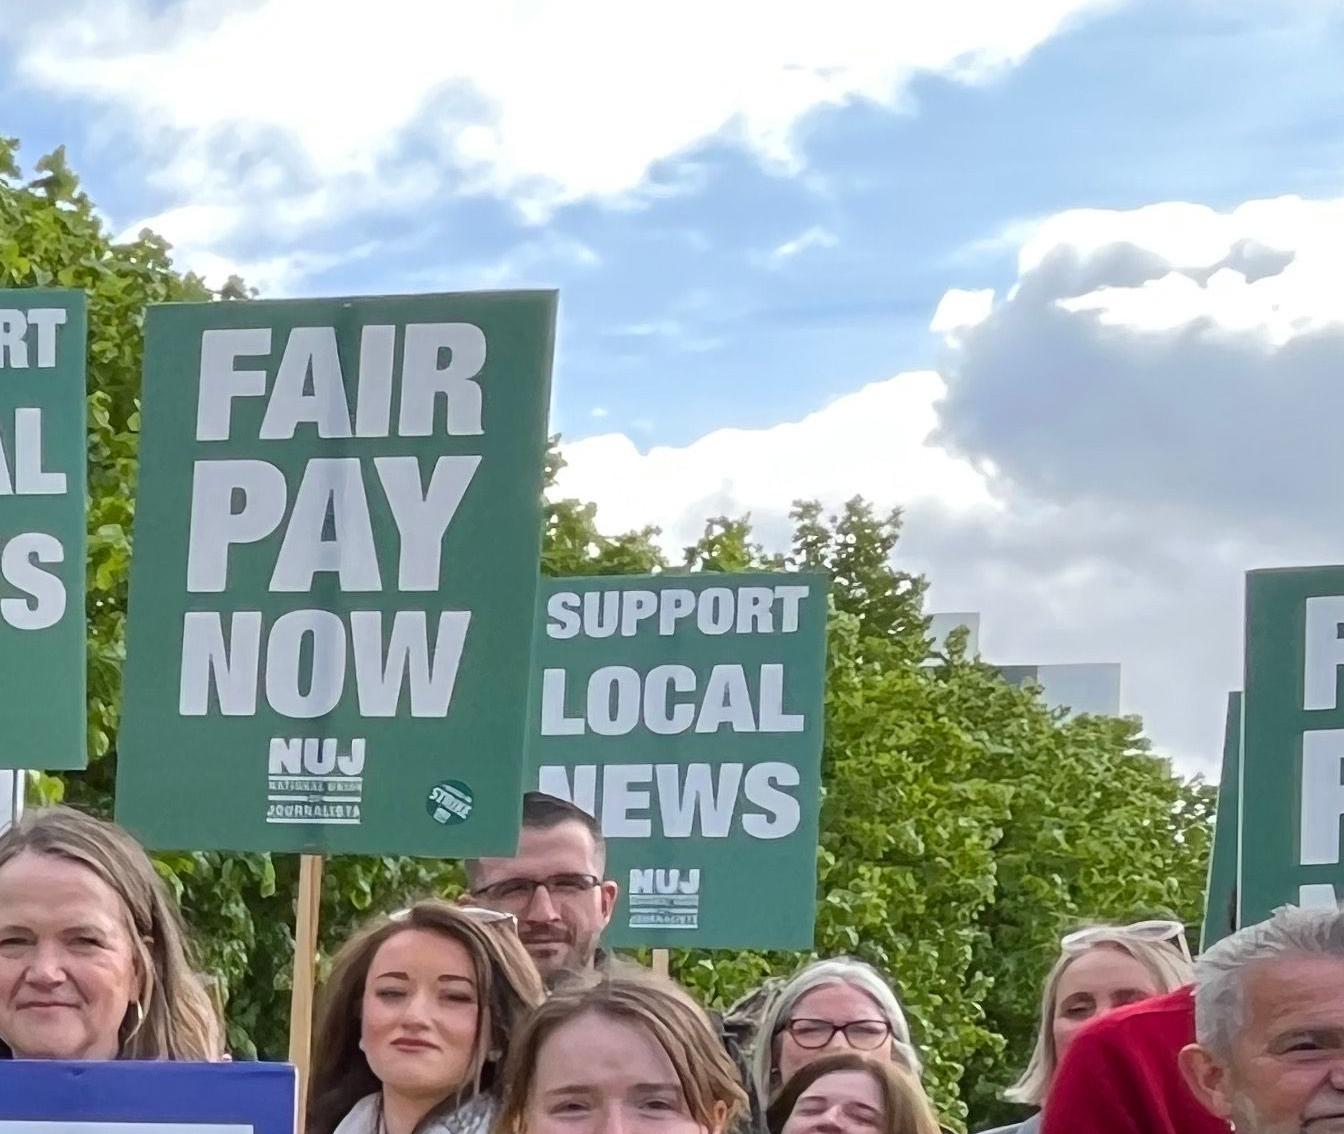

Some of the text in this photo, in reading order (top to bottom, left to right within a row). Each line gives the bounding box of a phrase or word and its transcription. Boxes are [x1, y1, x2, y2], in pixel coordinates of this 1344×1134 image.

[197, 323, 486, 440] FAIR
[187, 456, 482, 592] PAY
[547, 586, 809, 639] SUPPORT
[180, 610, 471, 718] NOW
[541, 664, 804, 735] LOCAL
[268, 738, 365, 775] NUJ
[539, 762, 801, 839] NEWS
[629, 869, 700, 894] NUJ
